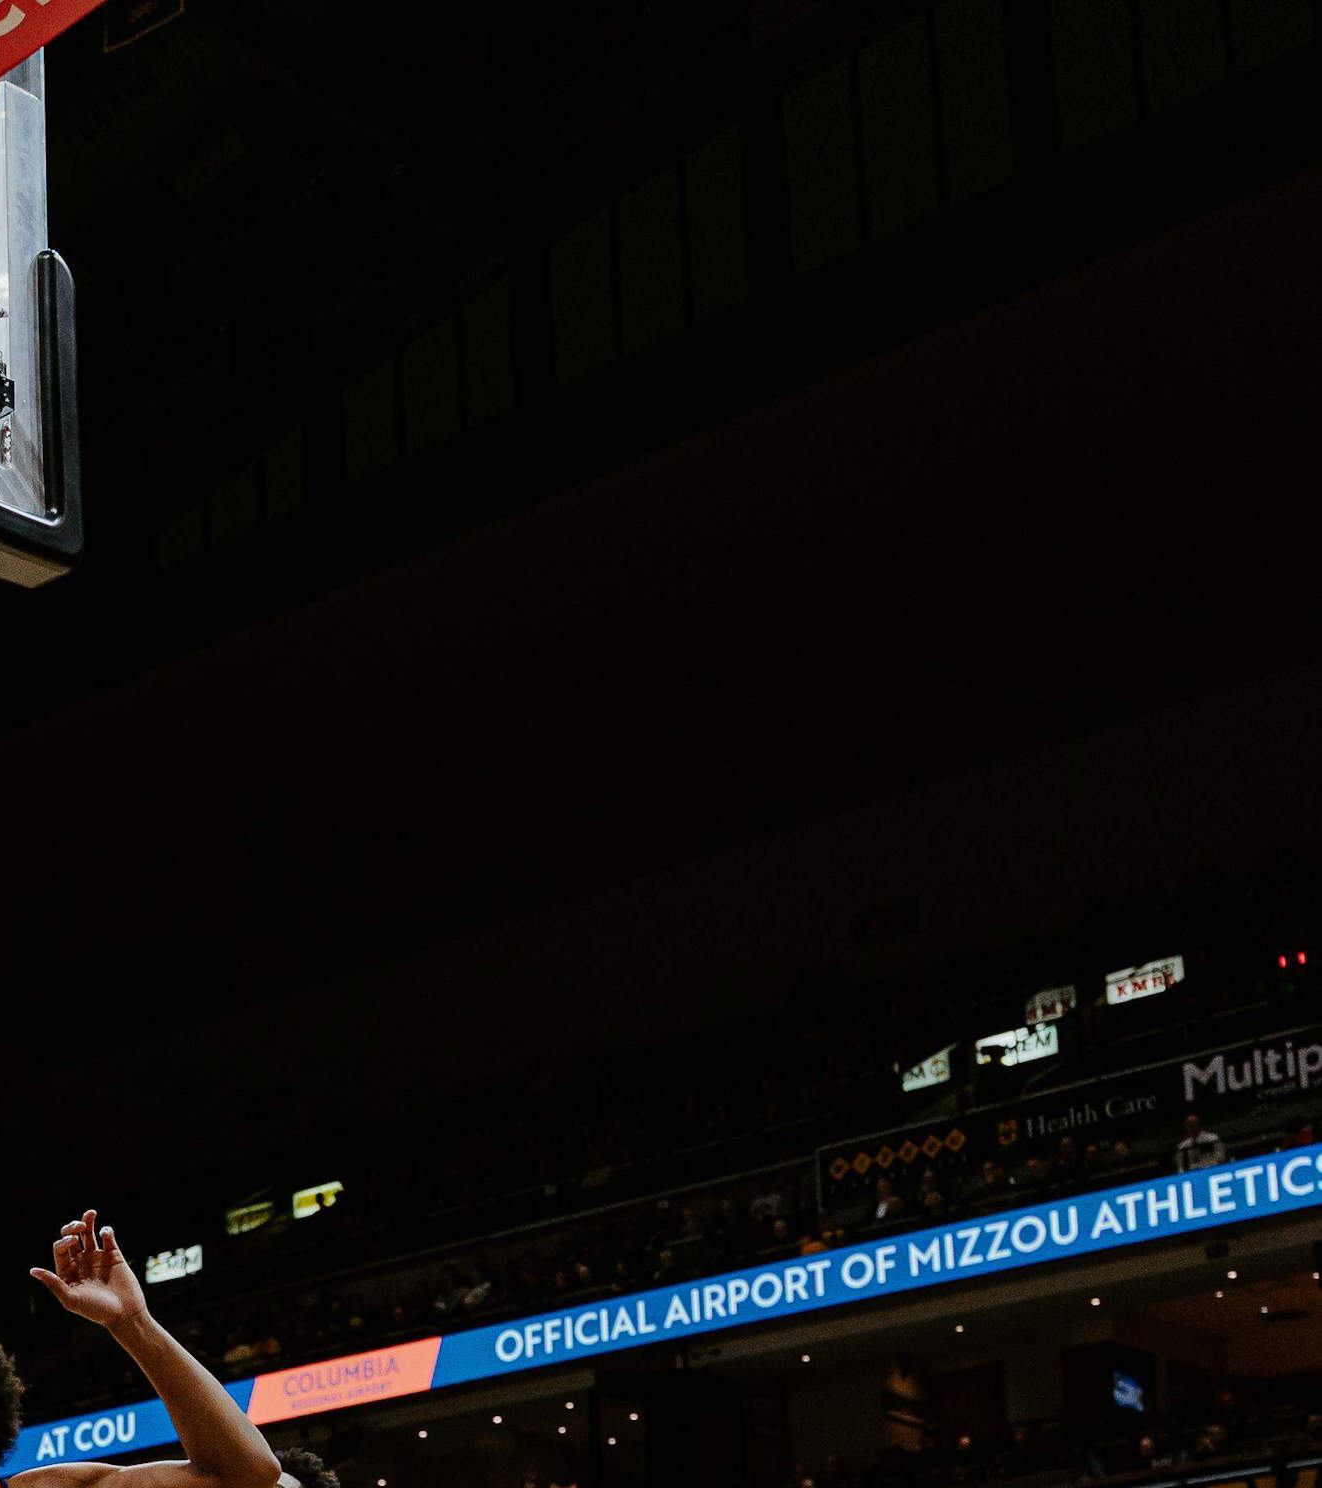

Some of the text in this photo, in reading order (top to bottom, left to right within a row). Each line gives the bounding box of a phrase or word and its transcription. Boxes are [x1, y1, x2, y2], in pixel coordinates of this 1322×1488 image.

[1026, 1096, 1156, 1139] Health Care
[495, 1300, 655, 1362] OFFICIAL
[663, 1260, 831, 1329] AIRPORT
[840, 1245, 897, 1289] OF
[908, 1206, 1079, 1277] MIZZOU
[284, 1357, 400, 1397] COLUMBIA
[36, 1412, 136, 1461] AT COU
